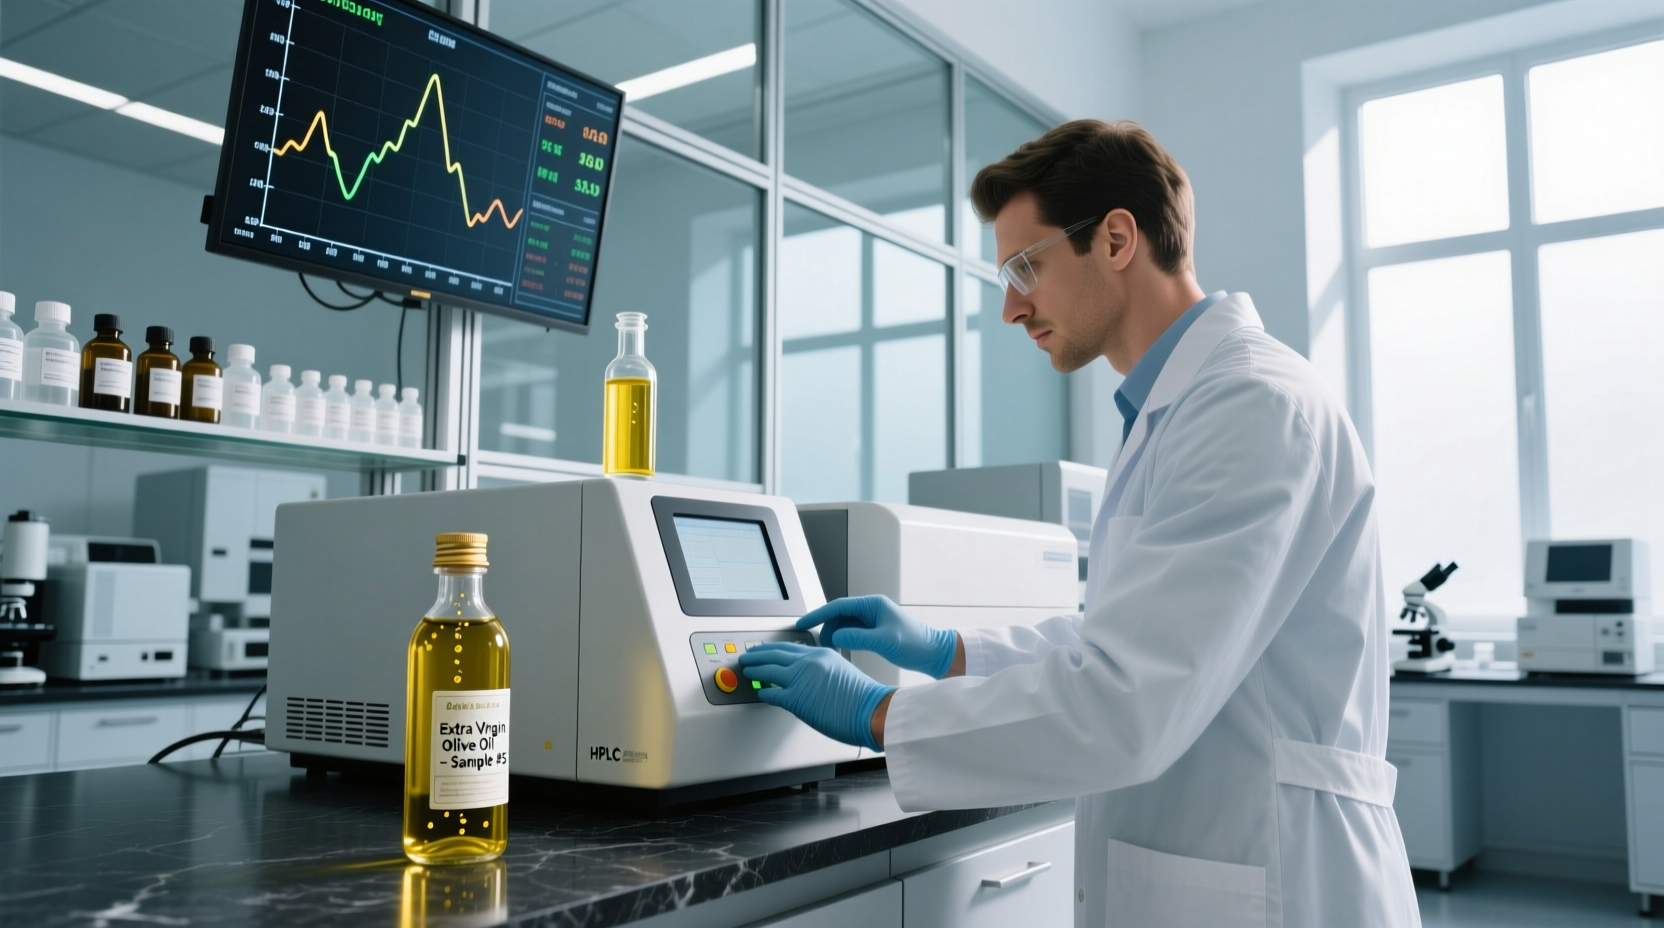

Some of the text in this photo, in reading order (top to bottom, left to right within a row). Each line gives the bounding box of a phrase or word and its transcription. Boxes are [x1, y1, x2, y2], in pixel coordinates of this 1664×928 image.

[440, 722, 473, 736] Extra
[442, 736, 494, 752] Olive Oil
[590, 745, 622, 762] HPLC
[451, 752, 494, 772] Sample
